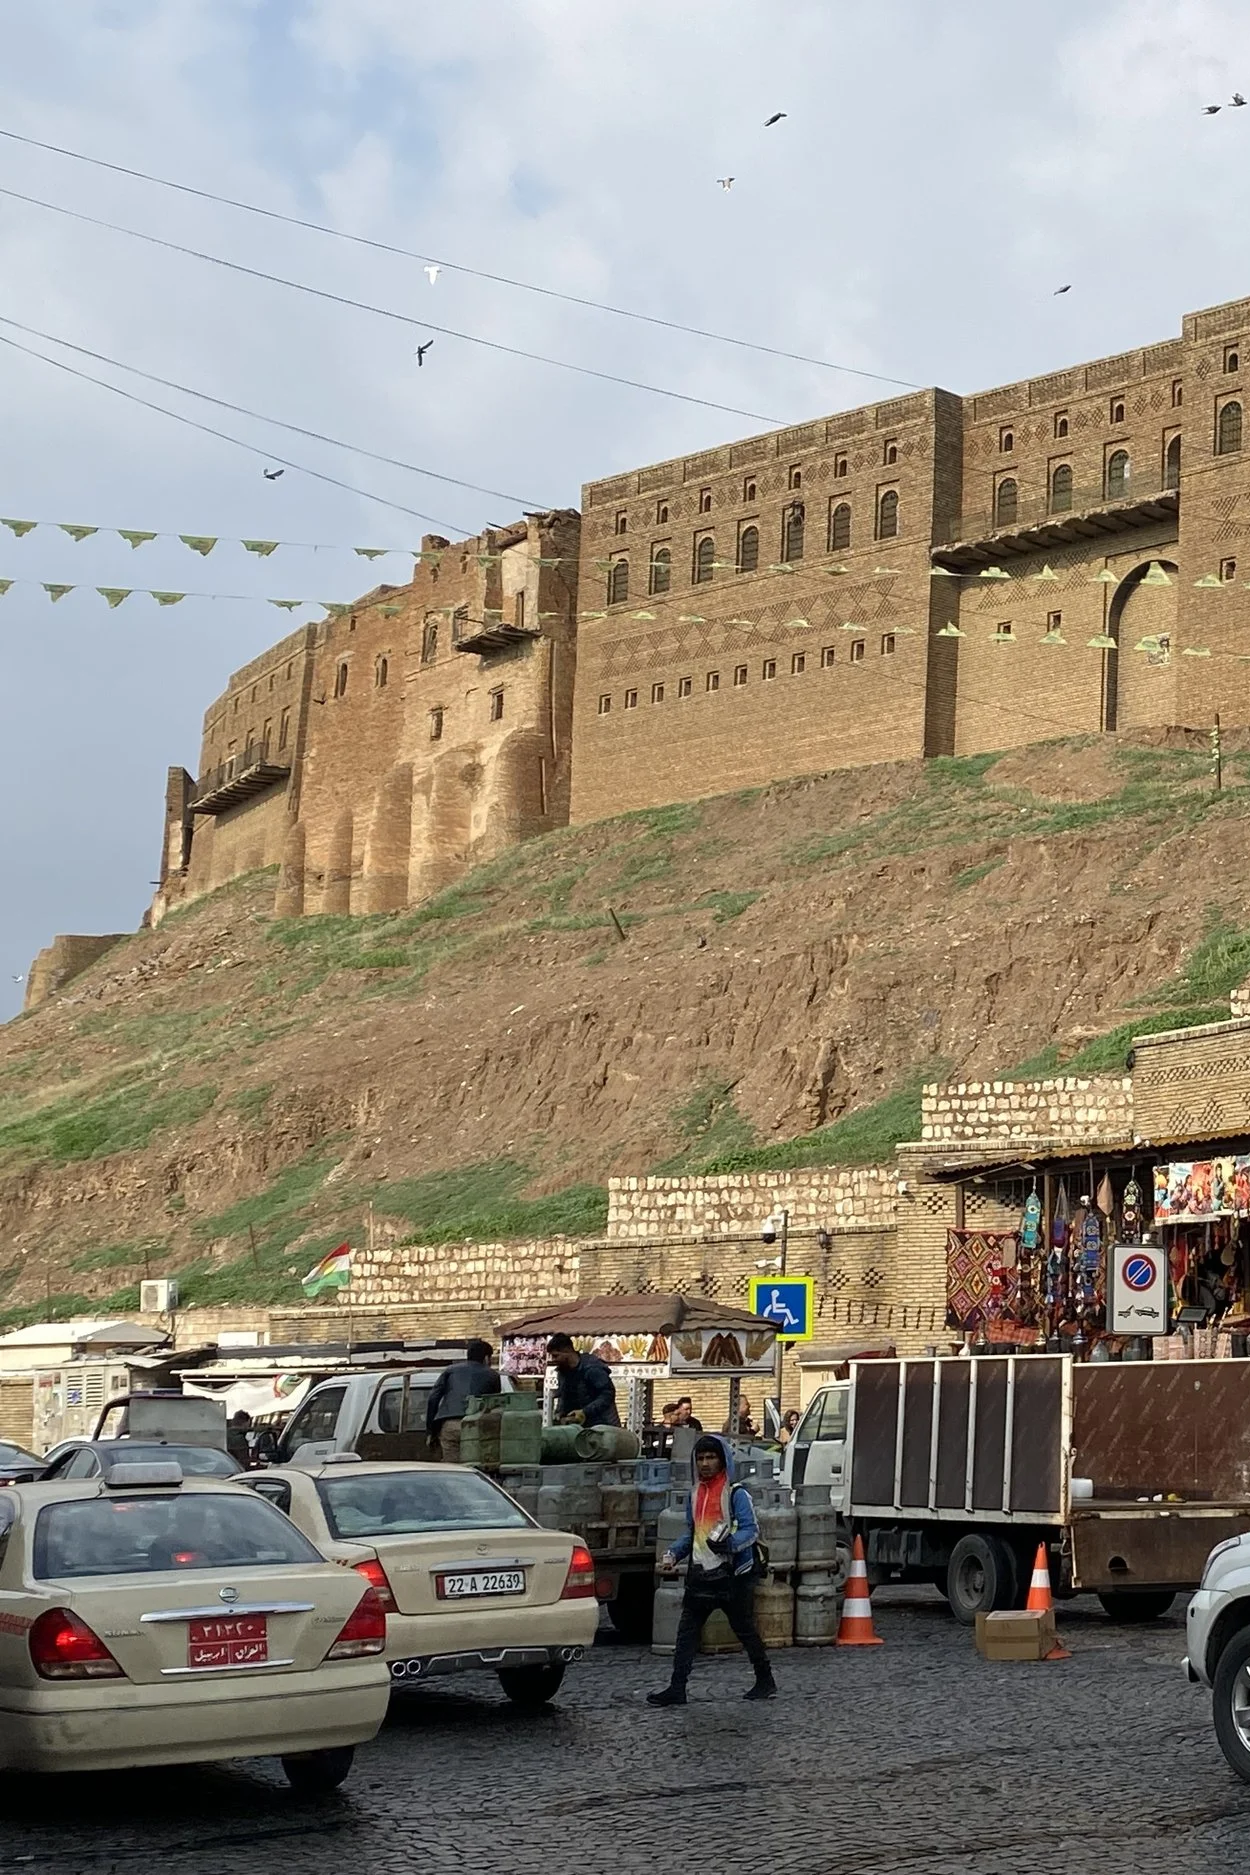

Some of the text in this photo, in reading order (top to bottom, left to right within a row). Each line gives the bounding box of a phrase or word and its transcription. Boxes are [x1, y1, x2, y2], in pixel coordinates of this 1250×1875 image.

[448, 1574, 520, 1593] 22 A 22639
